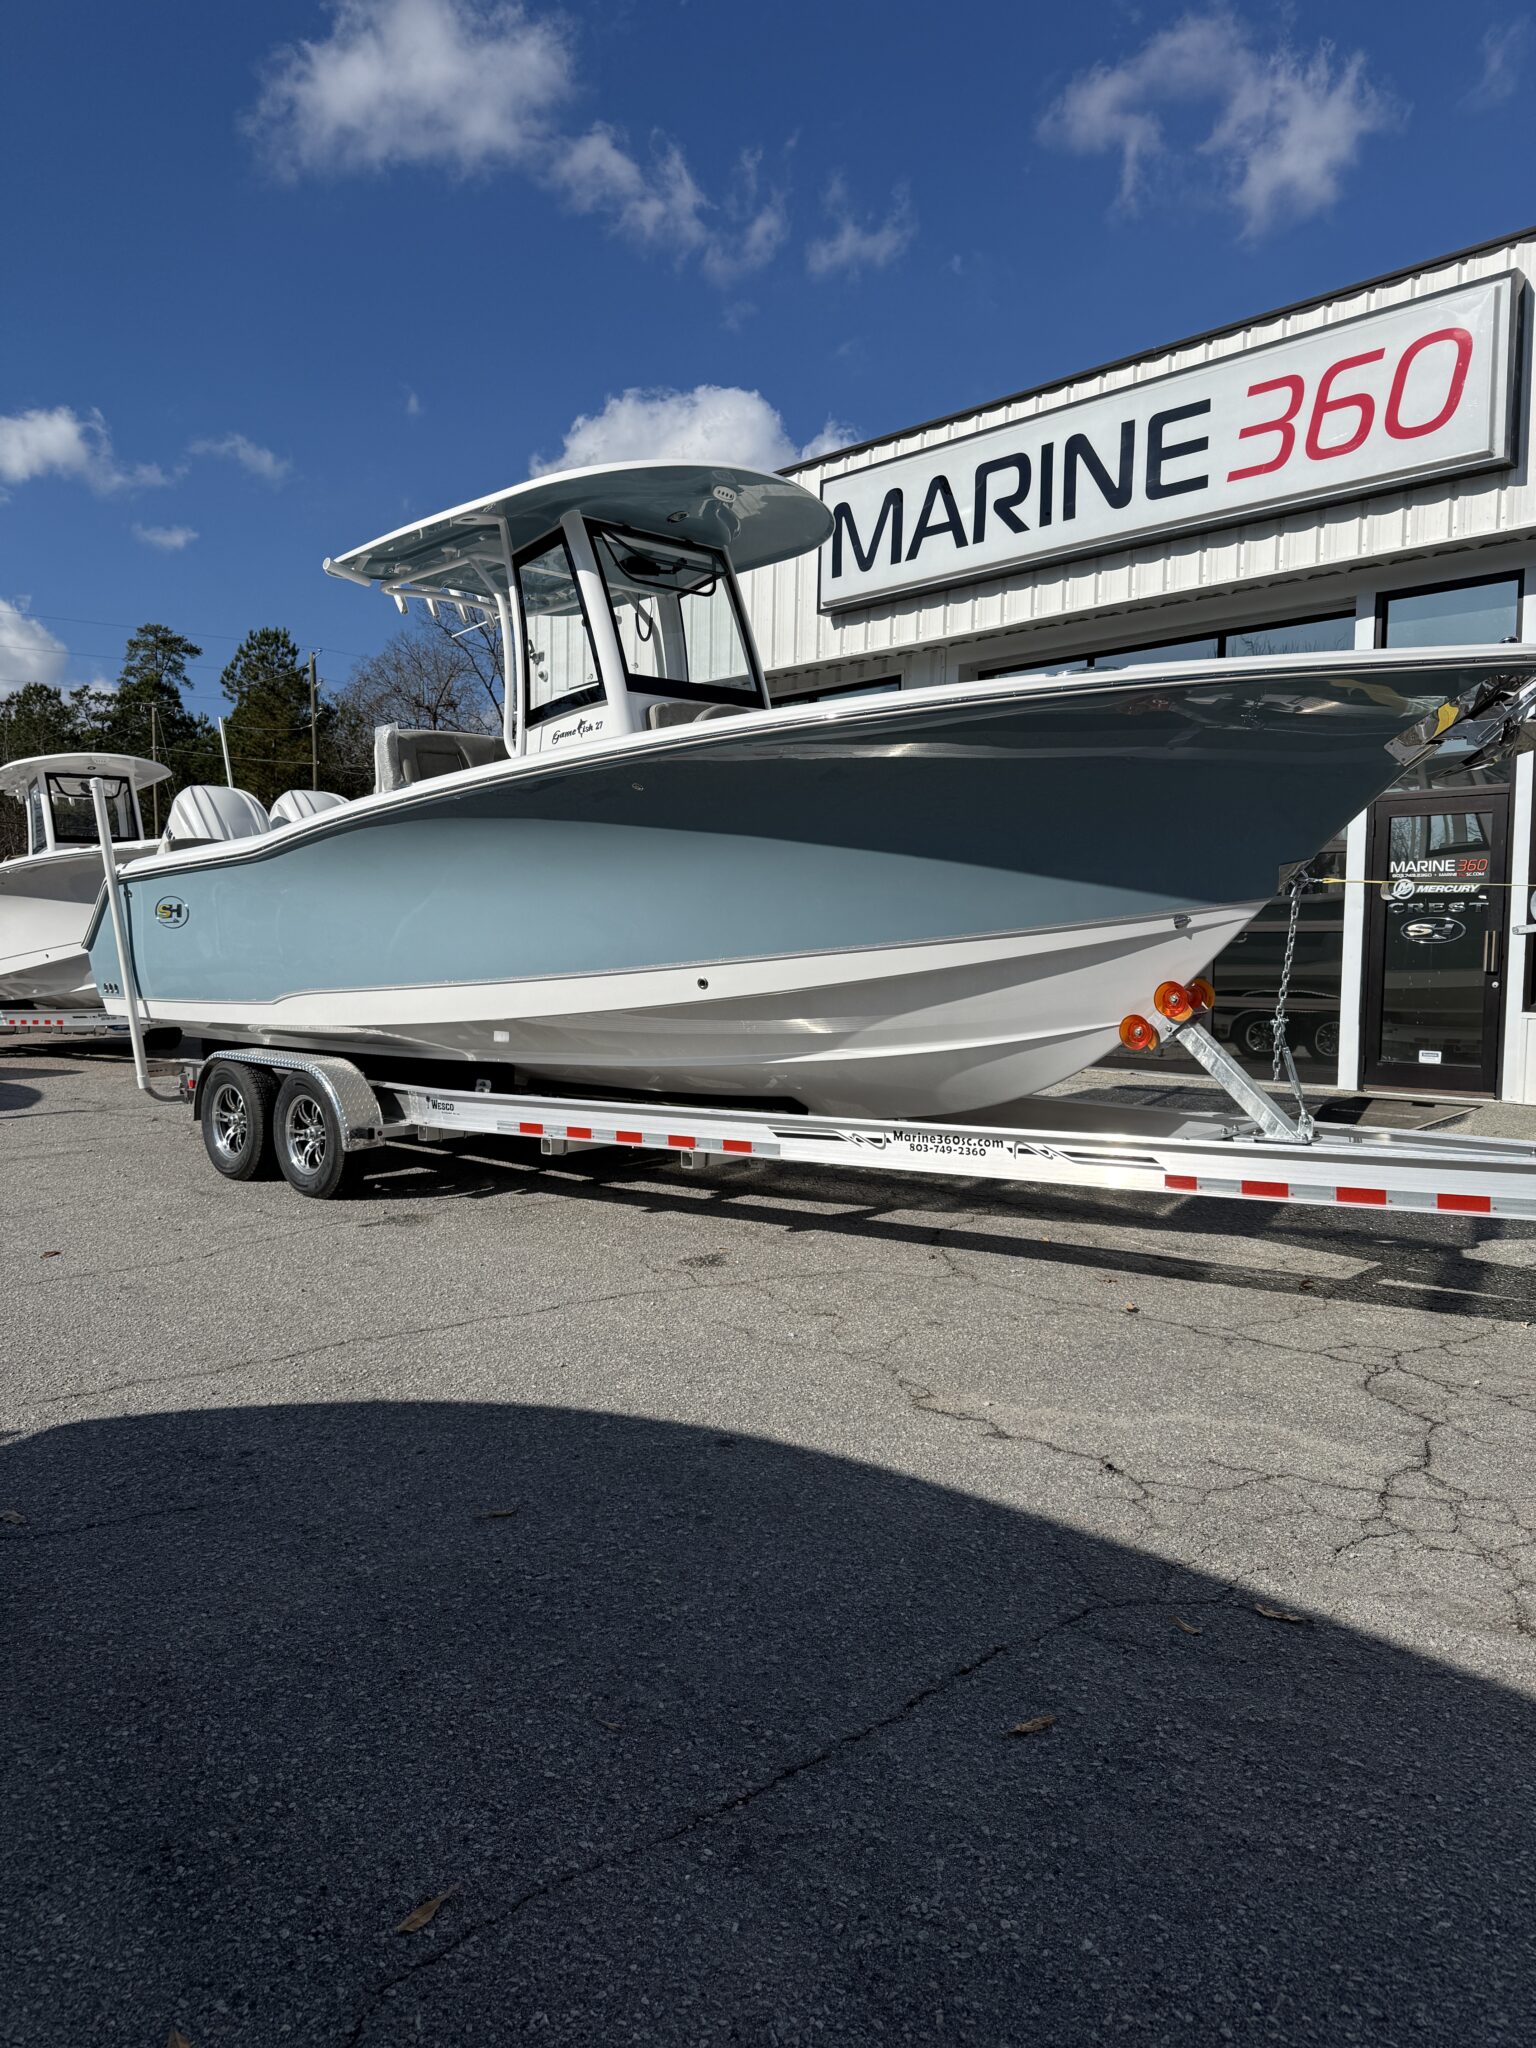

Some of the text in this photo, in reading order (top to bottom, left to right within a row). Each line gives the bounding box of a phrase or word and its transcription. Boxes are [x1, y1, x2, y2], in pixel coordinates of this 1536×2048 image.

[832, 327, 1473, 578] MARINE 360
[595, 720, 603, 730] 27
[1456, 858, 1488, 872] 360
[1416, 884, 1480, 893] MERCURY
[1388, 901, 1489, 913] CREST
[893, 1130, 1004, 1148] Marine360sc.com
[909, 1143, 987, 1157] 803-749-2360
